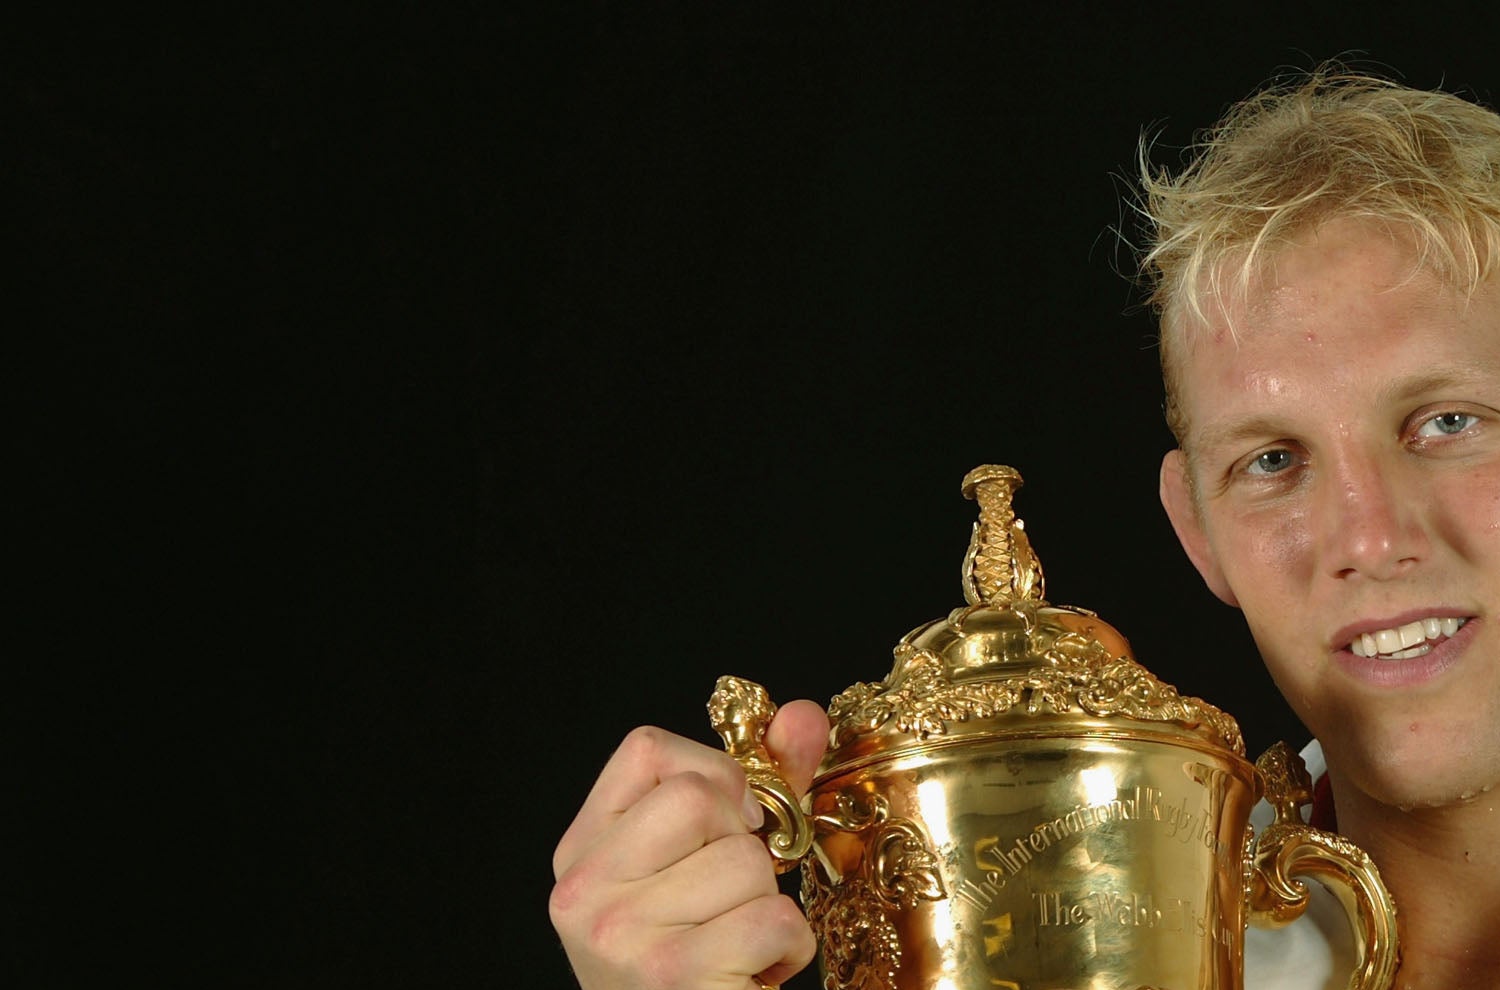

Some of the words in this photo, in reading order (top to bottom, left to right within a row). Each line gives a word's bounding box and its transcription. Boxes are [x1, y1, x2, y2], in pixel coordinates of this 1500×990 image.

[954, 871, 1006, 914] The
[984, 786, 1141, 876] International
[1031, 892, 1086, 927] The
